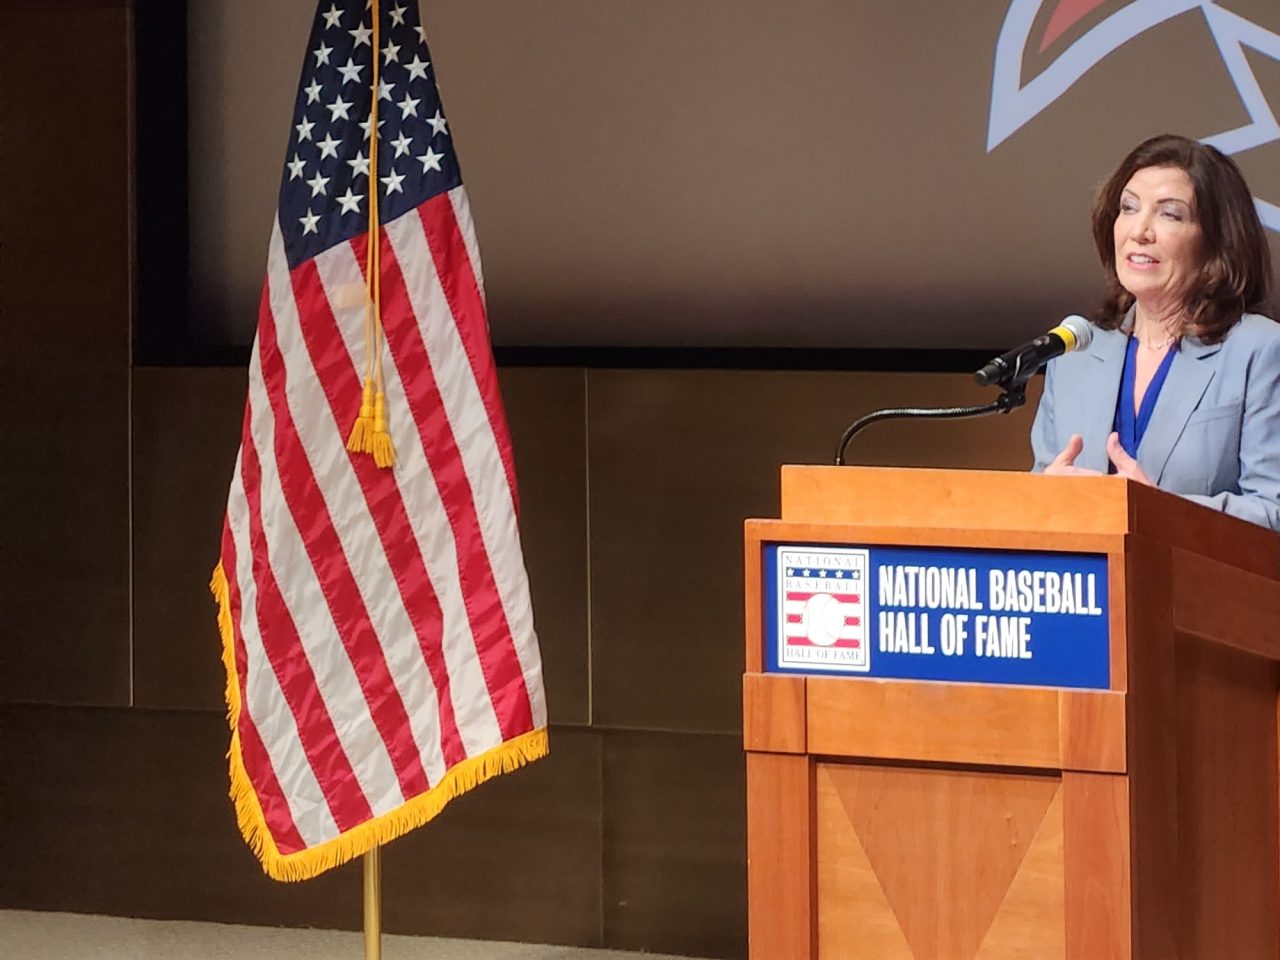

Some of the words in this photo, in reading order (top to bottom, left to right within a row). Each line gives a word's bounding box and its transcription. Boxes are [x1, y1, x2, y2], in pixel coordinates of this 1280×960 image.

[878, 565, 983, 610] NATIONAL
[988, 569, 1102, 616] BASEBALL
[878, 611, 935, 655] HALL
[940, 613, 968, 656] OF
[974, 615, 1033, 659] FAME
